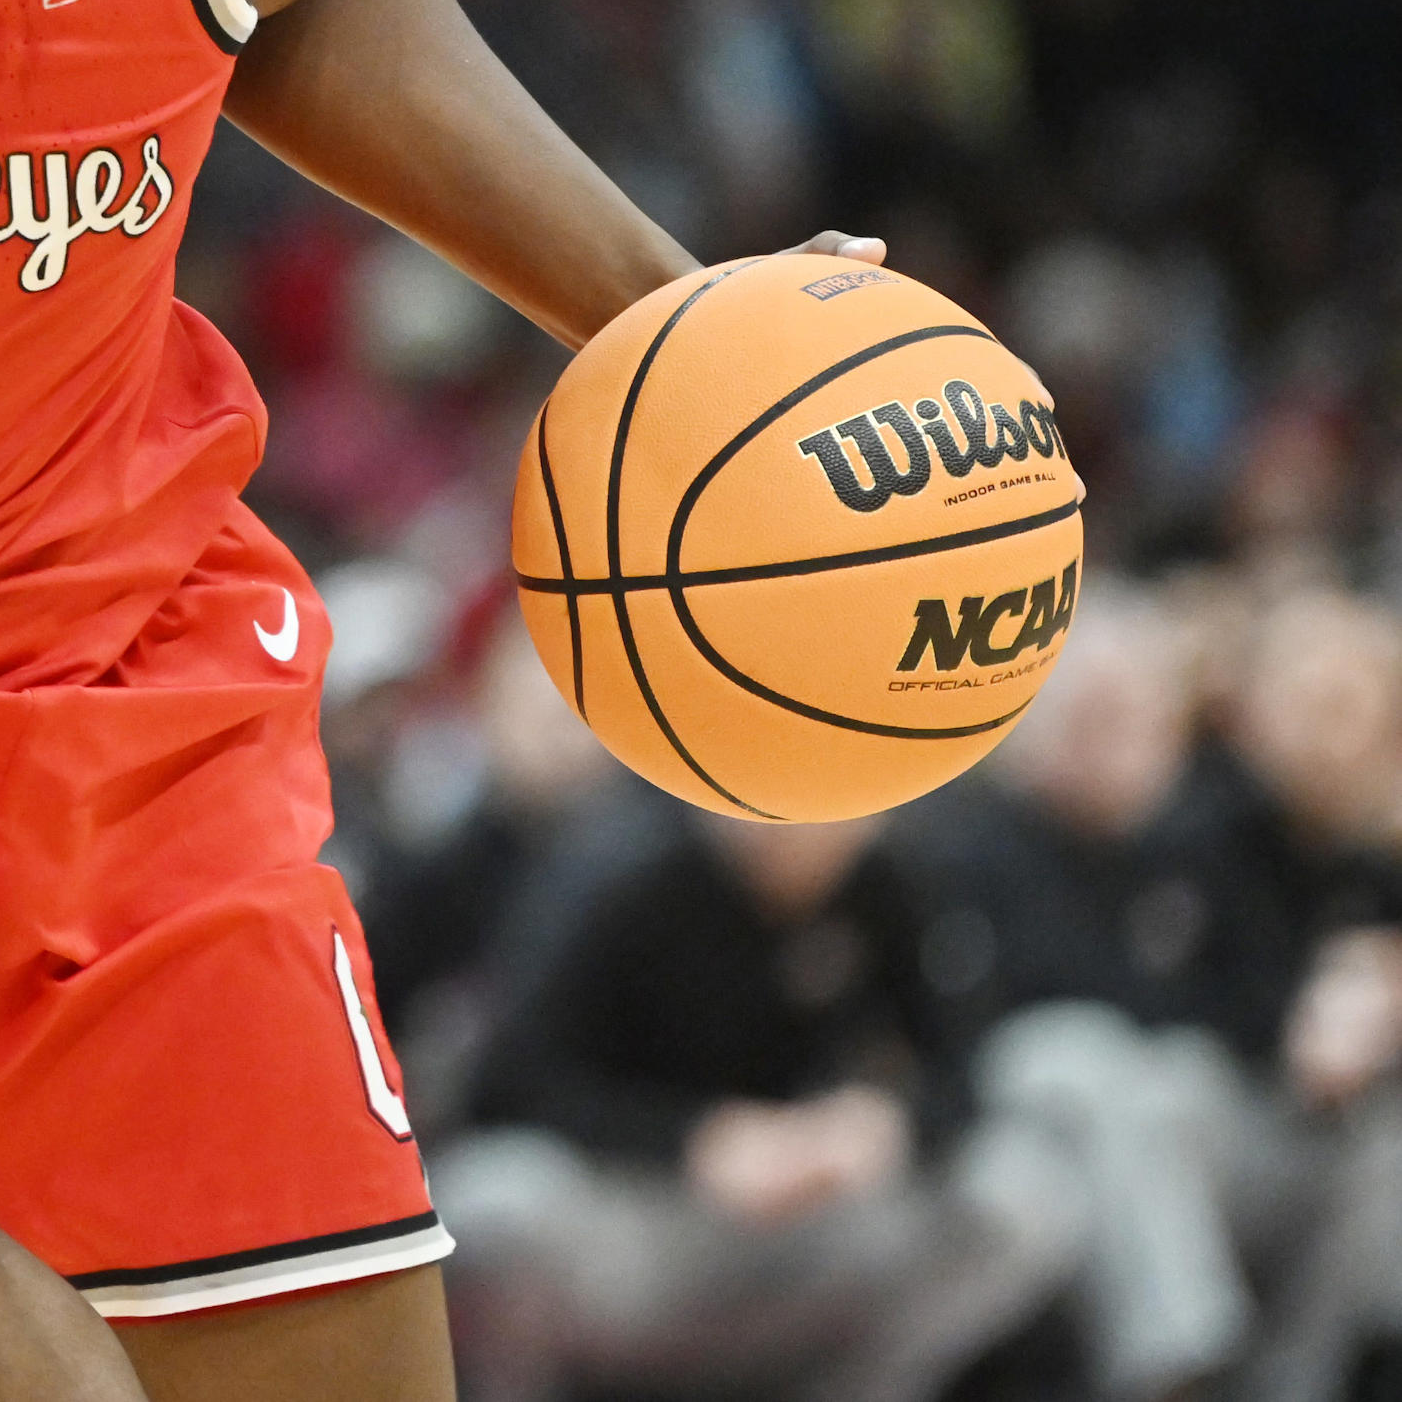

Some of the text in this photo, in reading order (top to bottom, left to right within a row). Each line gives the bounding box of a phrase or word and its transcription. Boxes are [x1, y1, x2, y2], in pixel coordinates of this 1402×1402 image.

[944, 473, 1056, 506] INDOOR GAME BALL
[895, 556, 1080, 672] NCAA
[888, 678, 985, 692] OFFICIAL
[990, 661, 1038, 684] GAME
